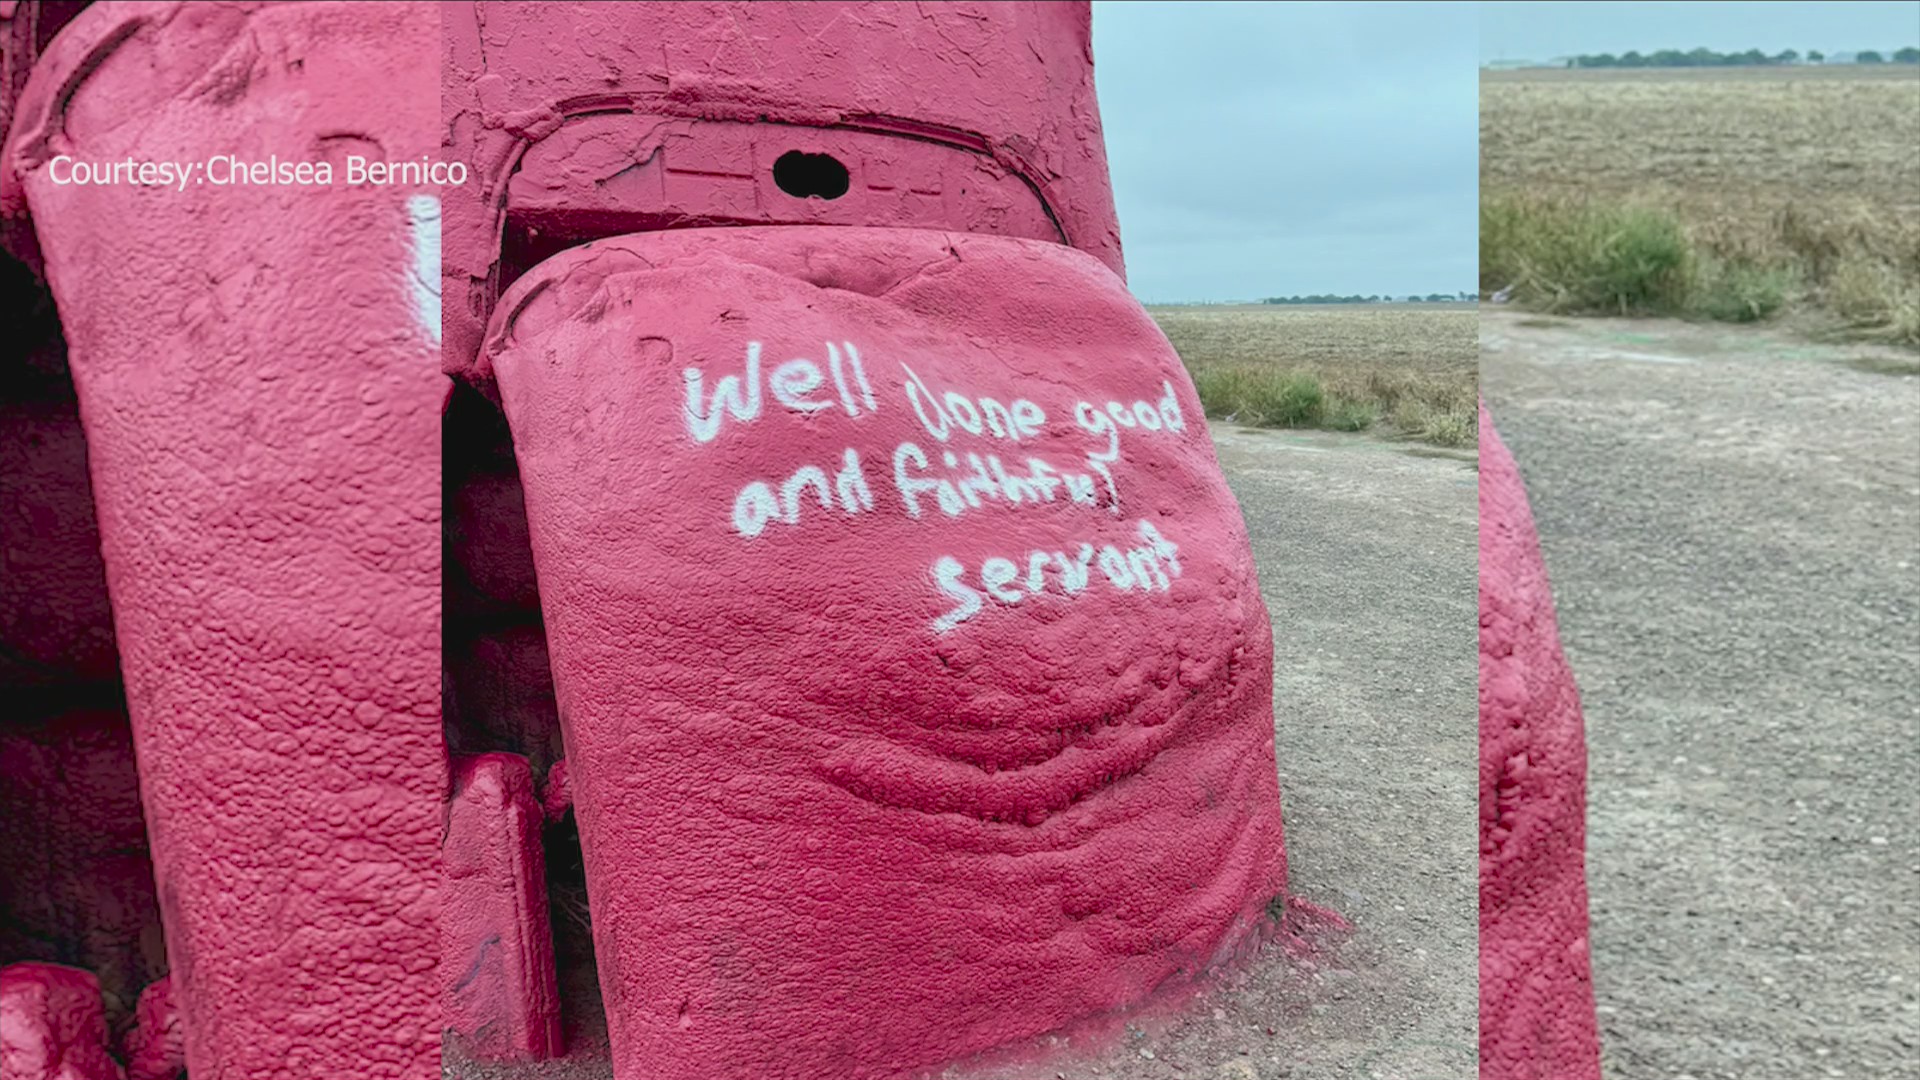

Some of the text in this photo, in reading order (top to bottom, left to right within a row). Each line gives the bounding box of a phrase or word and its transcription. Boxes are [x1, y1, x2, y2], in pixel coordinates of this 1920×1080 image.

[684, 341, 1184, 465] Well done good
[731, 442, 1120, 537] and faithful
[932, 519, 1182, 635] servant
